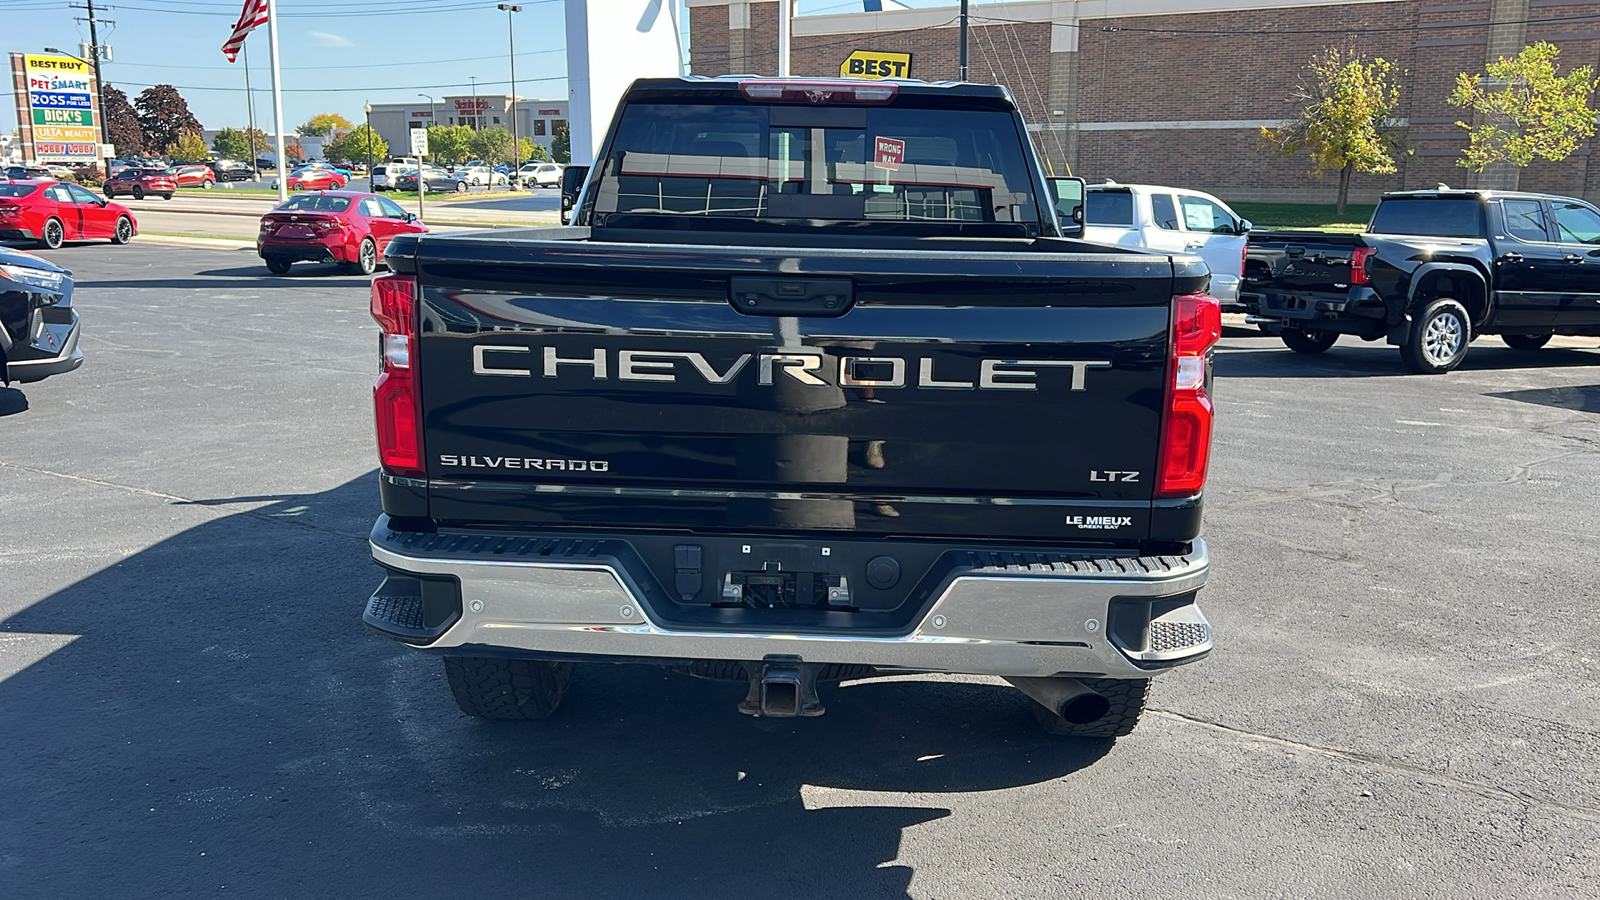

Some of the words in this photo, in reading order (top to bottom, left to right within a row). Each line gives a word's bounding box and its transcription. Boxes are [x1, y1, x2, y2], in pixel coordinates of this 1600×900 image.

[30, 60, 57, 68] BEST
[59, 62, 82, 70] BUY
[849, 59, 906, 77] BEST
[31, 94, 66, 105] ROSS
[454, 98, 489, 109] Steinhfels
[44, 110, 82, 122] DICK'S
[38, 127, 63, 137] ULTA
[64, 130, 94, 138] BEAUTY
[37, 144, 65, 153] HOBBY
[68, 144, 94, 153] LOBBY
[878, 142, 901, 154] WRONG
[882, 154, 896, 163] WAY
[472, 344, 1112, 391] CHEVROLET
[440, 454, 609, 472] SILVERADO
[1090, 470, 1140, 482] LTZ
[1066, 515, 1083, 525] LE
[1086, 516, 1132, 526] MIEUX
